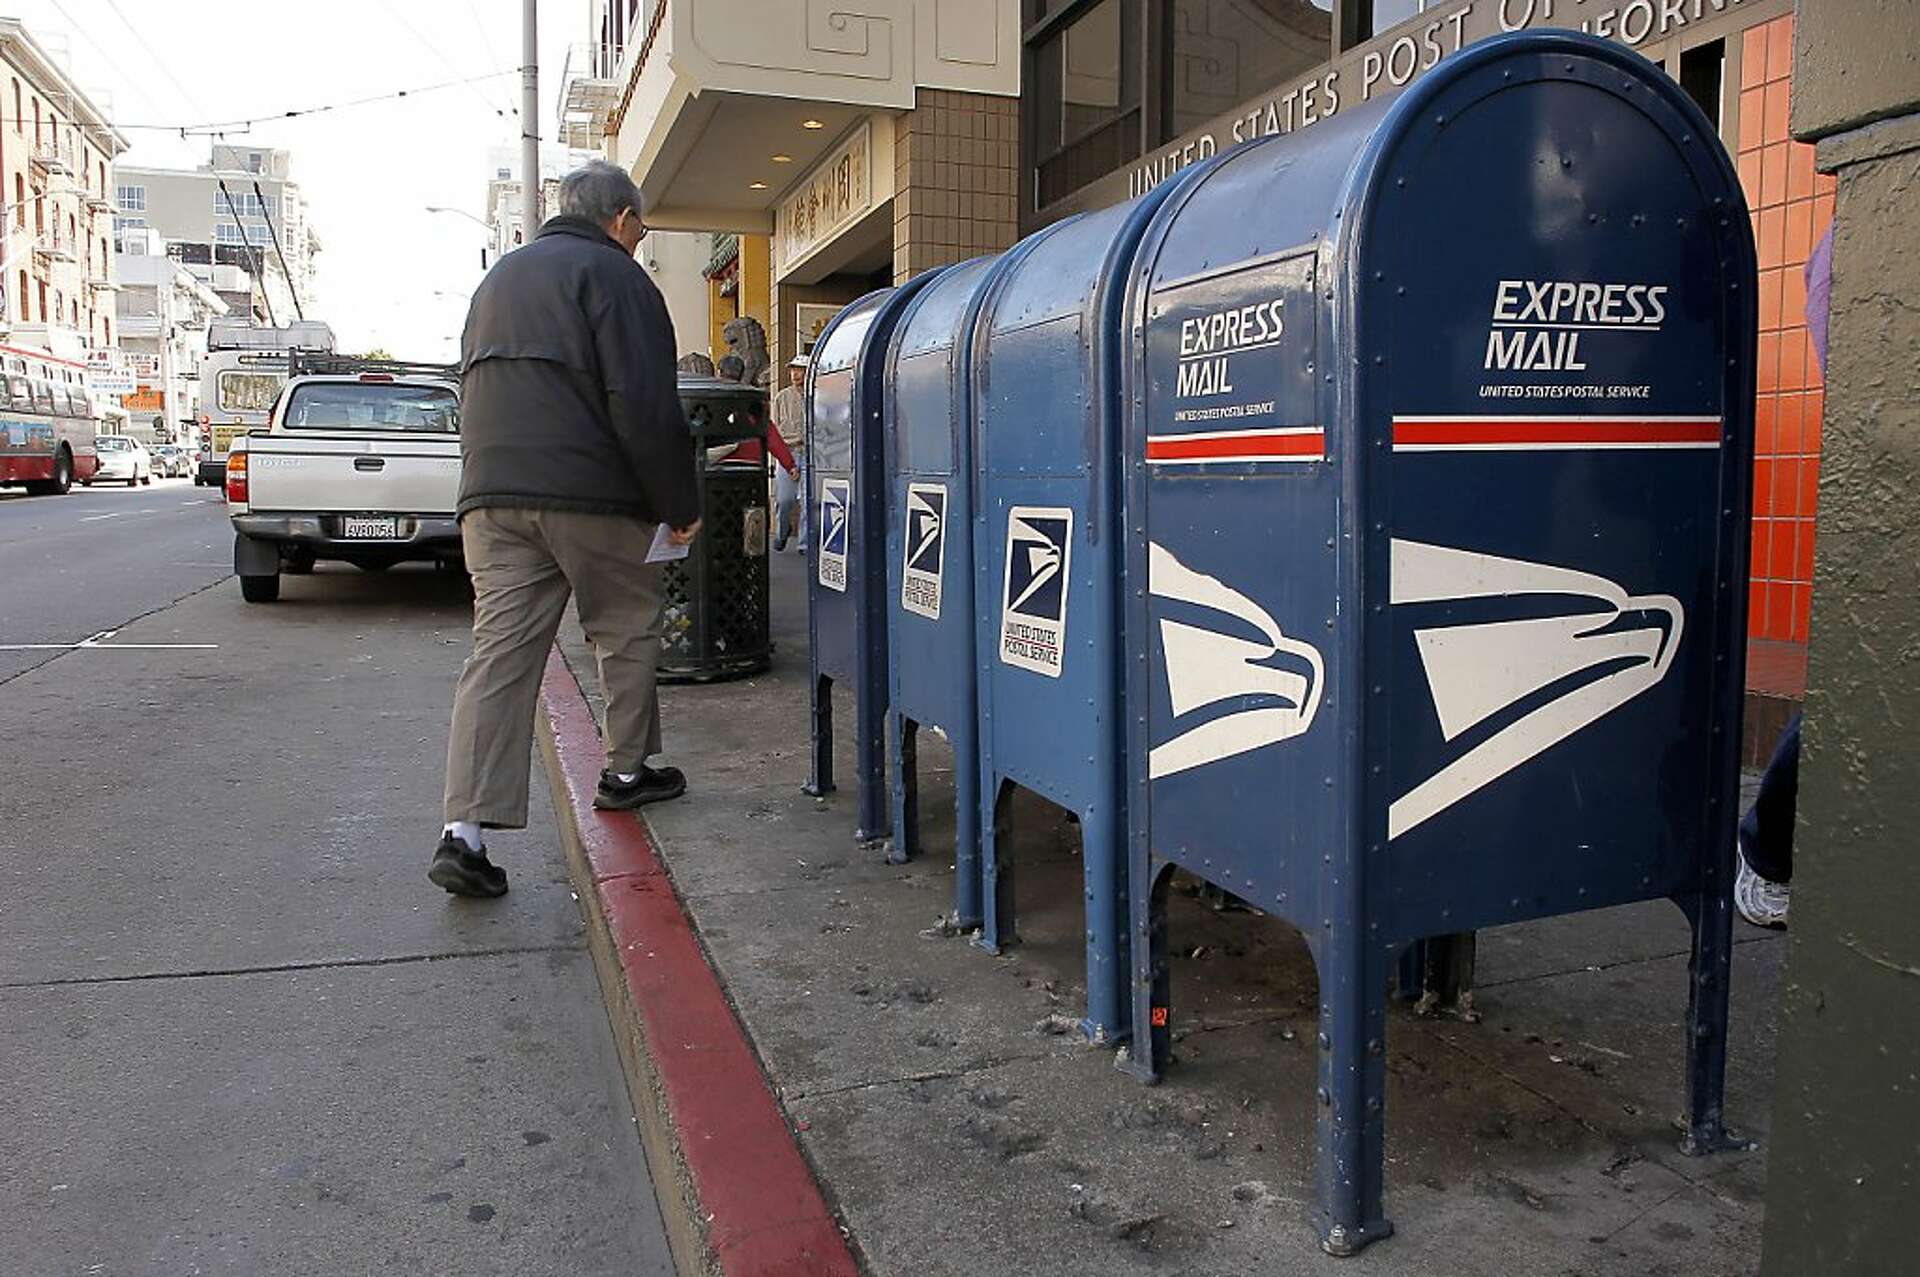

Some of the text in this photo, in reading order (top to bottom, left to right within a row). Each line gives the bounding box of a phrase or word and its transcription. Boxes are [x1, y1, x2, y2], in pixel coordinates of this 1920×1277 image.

[1232, 71, 1339, 143] STATES
[1361, 5, 1471, 100] POST
[1493, 280, 1668, 324] EXPRESS
[1180, 299, 1284, 355] EXPRESS
[1484, 331, 1587, 370] MAIL
[1176, 357, 1233, 398] MAIL
[1479, 385, 1651, 398] UNITED STATES POSTAL SERVICE
[1246, 401, 1275, 415] SERVICE
[1030, 645, 1058, 666] SERVICE
